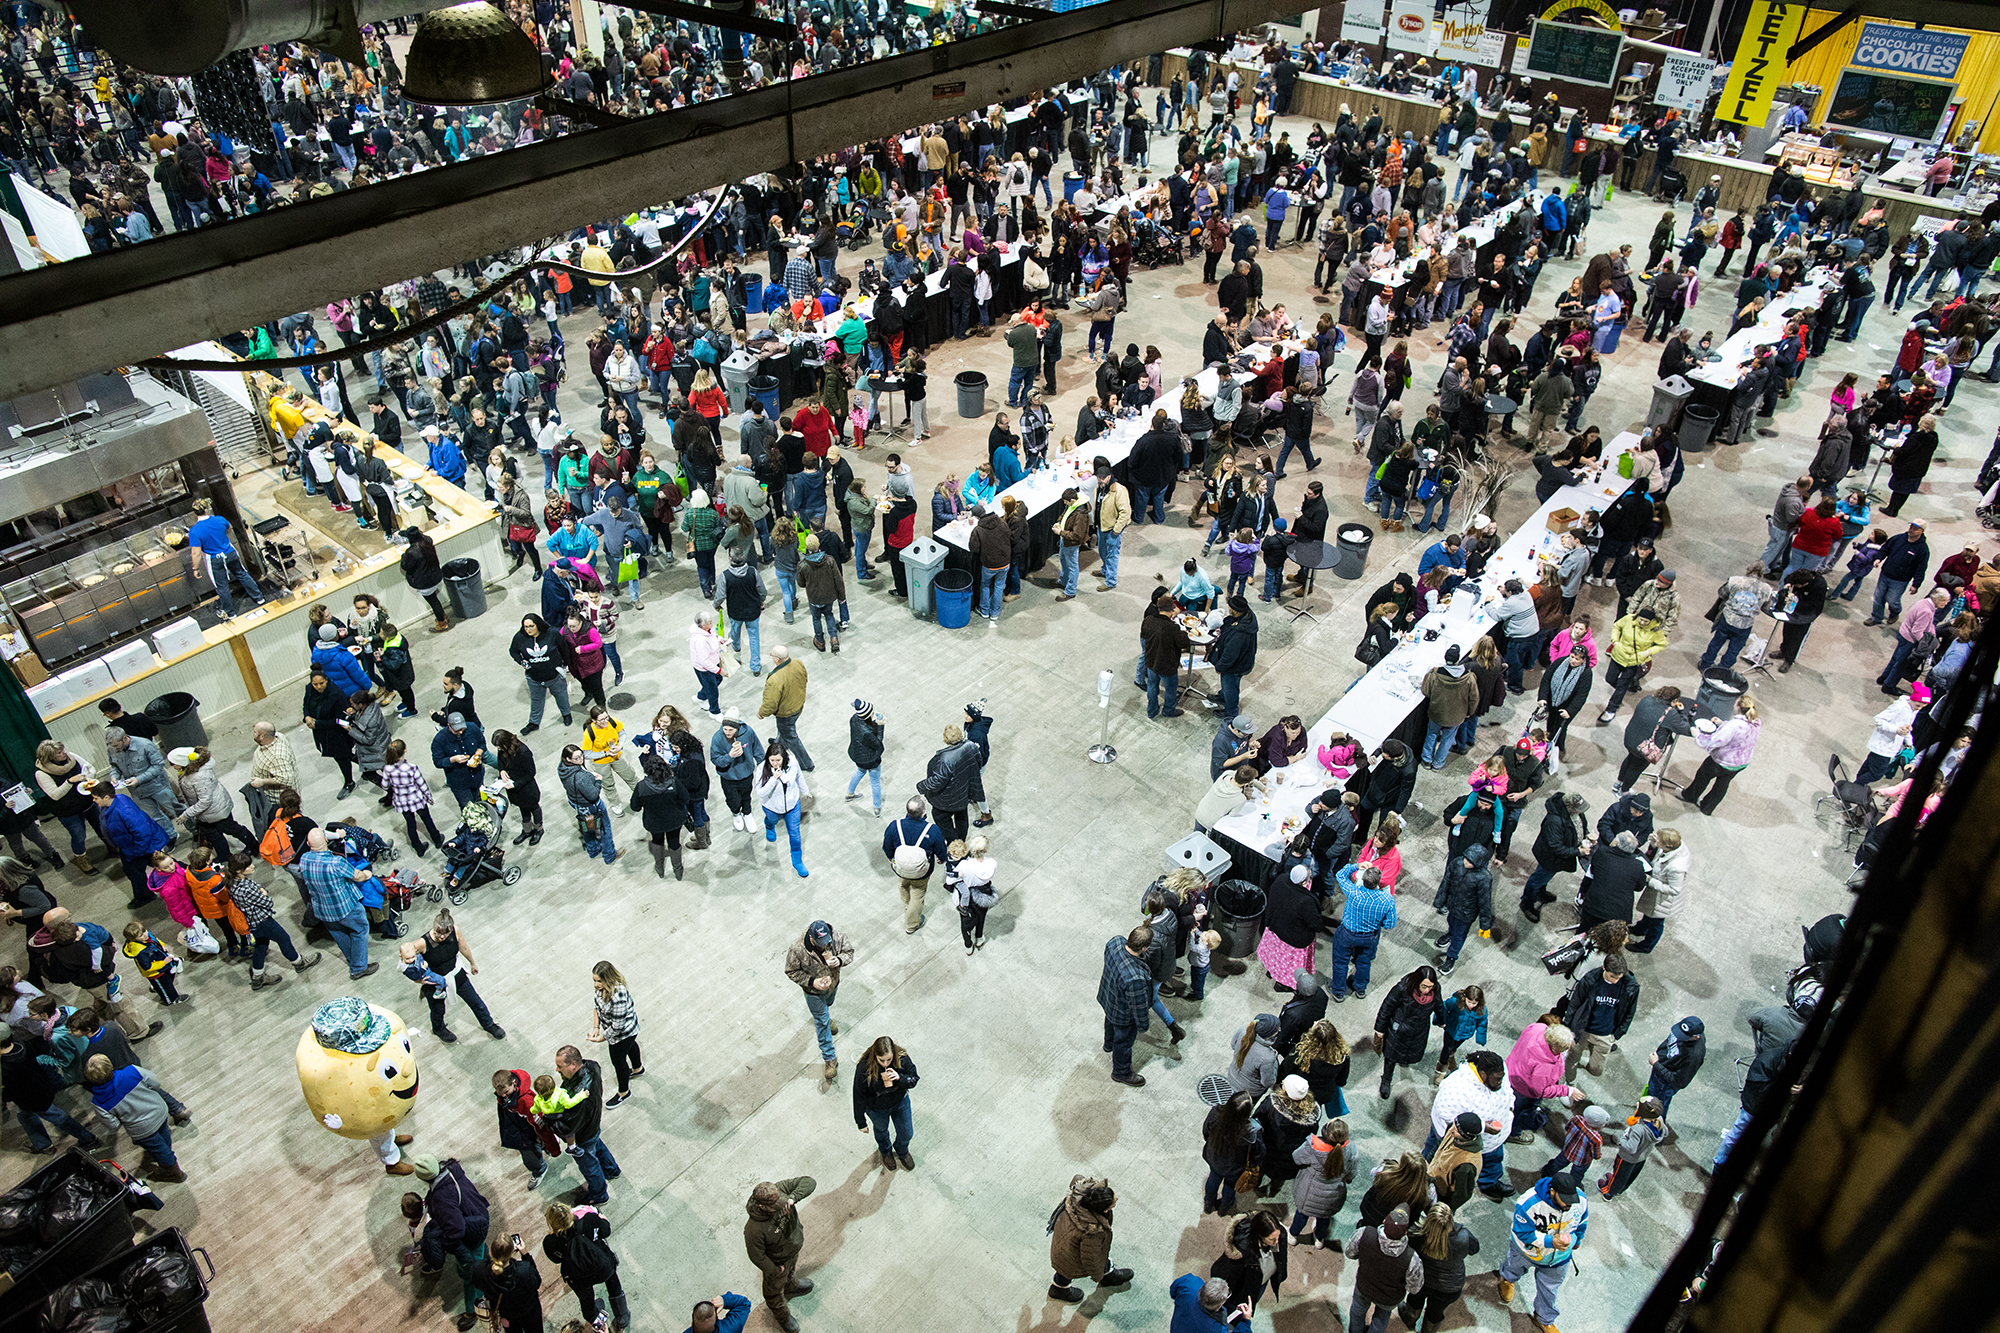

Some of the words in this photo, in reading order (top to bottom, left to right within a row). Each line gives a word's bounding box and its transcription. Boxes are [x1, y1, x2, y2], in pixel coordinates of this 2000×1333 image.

[1401, 16, 1424, 29] Tyson
[1443, 19, 1484, 41] Martin's
[1864, 26, 1892, 37] FRESH
[1892, 30, 1911, 39] OUT
[1911, 32, 1924, 41] OF
[1925, 34, 1943, 43] THE
[1943, 37, 1968, 46] OVEN
[1483, 33, 1504, 42] ACHOS
[1440, 41, 1462, 50] POTATO
[1862, 35, 1931, 53] CHOCOLATE
[1933, 44, 1963, 57] CHIP
[1666, 57, 1690, 67] CREDIT
[1692, 61, 1715, 71] CARDS
[1856, 45, 1958, 74] COOKIES
[1670, 71, 1685, 79] THIS
[1687, 74, 1703, 82] LINE
[1671, 65, 1706, 76] ACCEPTED
[1675, 79, 1693, 87] ONLY
[1596, 996, 1619, 1005] OLLIST
